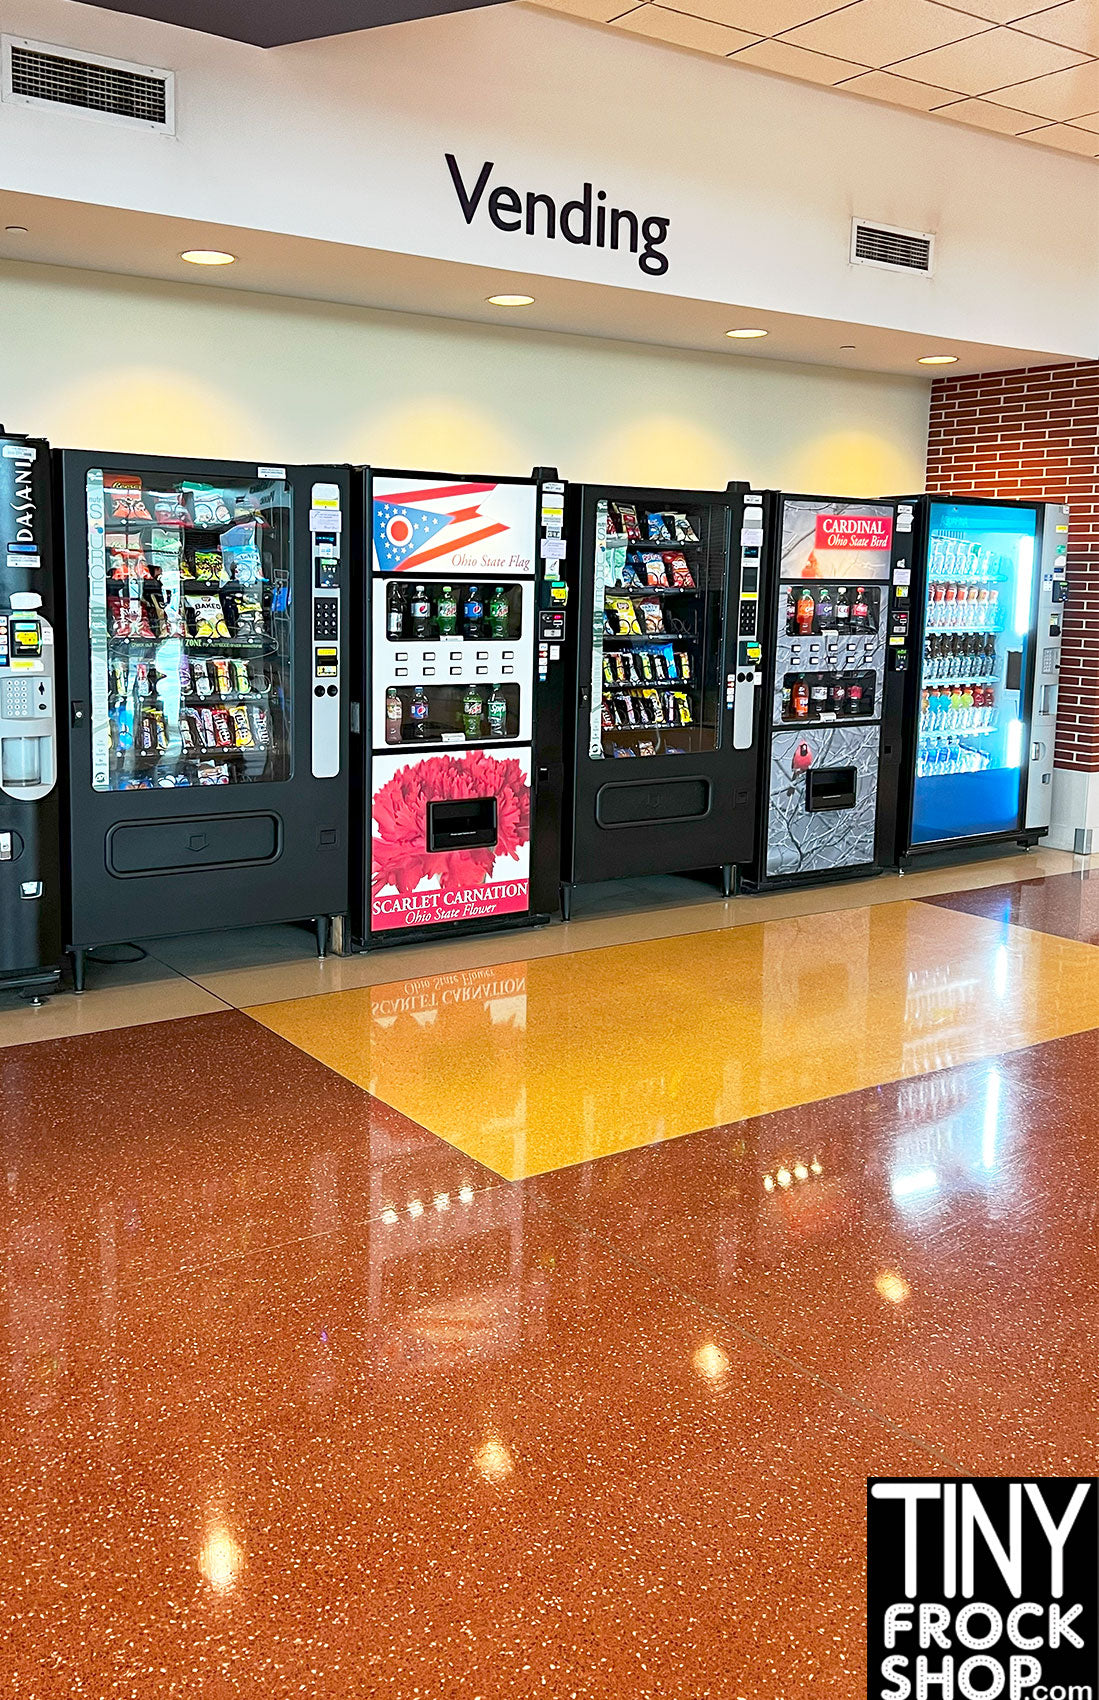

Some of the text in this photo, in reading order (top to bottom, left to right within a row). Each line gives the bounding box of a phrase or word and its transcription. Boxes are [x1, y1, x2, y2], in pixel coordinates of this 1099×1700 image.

[445, 153, 670, 276] Vending
[10, 461, 36, 541] DASANI
[823, 519, 886, 534] CARDINAL
[828, 534, 889, 547] Ohio State Bird
[451, 553, 531, 571] Ohio State Flag
[372, 882, 528, 915] SCARLET CARNATION
[405, 903, 497, 925] Ohio State Flower
